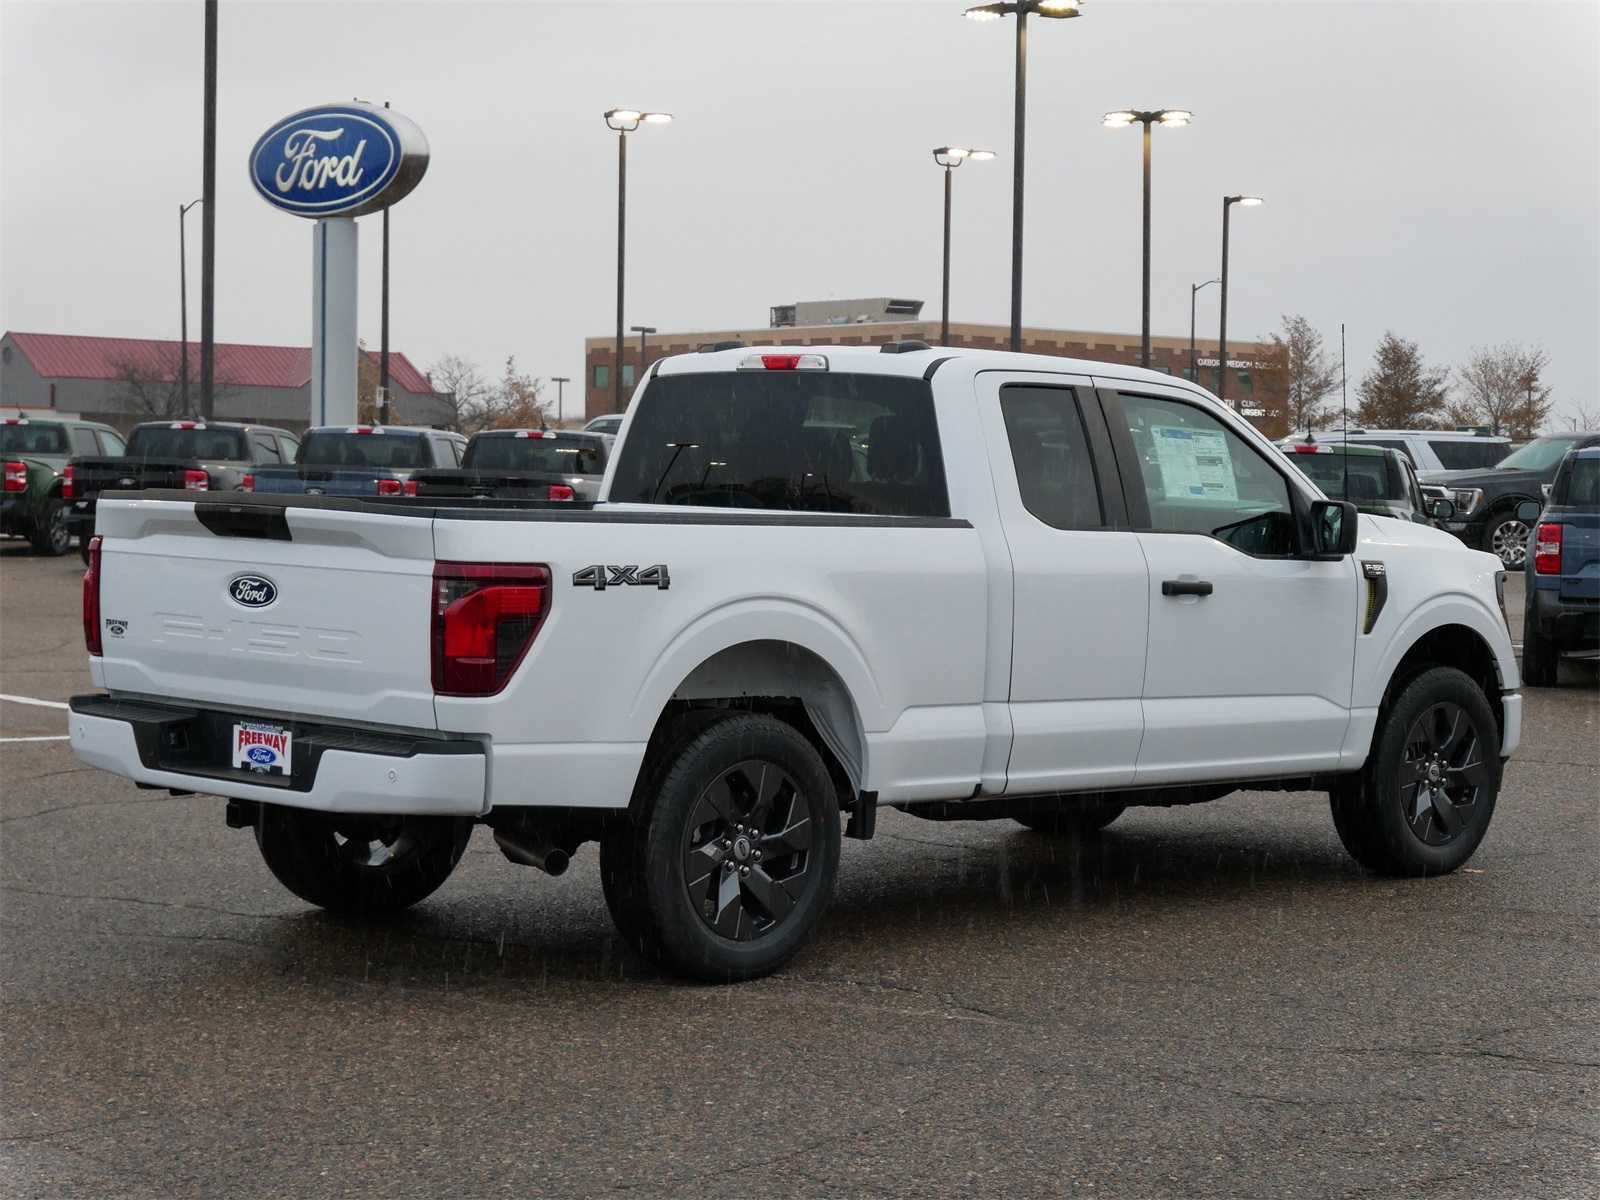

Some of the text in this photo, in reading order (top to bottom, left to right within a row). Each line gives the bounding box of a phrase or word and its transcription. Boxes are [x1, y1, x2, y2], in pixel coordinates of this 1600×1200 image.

[275, 127, 367, 193] Ford
[1197, 358, 1220, 367] OXBOR
[235, 579, 267, 603] Ford
[238, 729, 287, 759] FREEWAY
[251, 748, 271, 762] Ford
